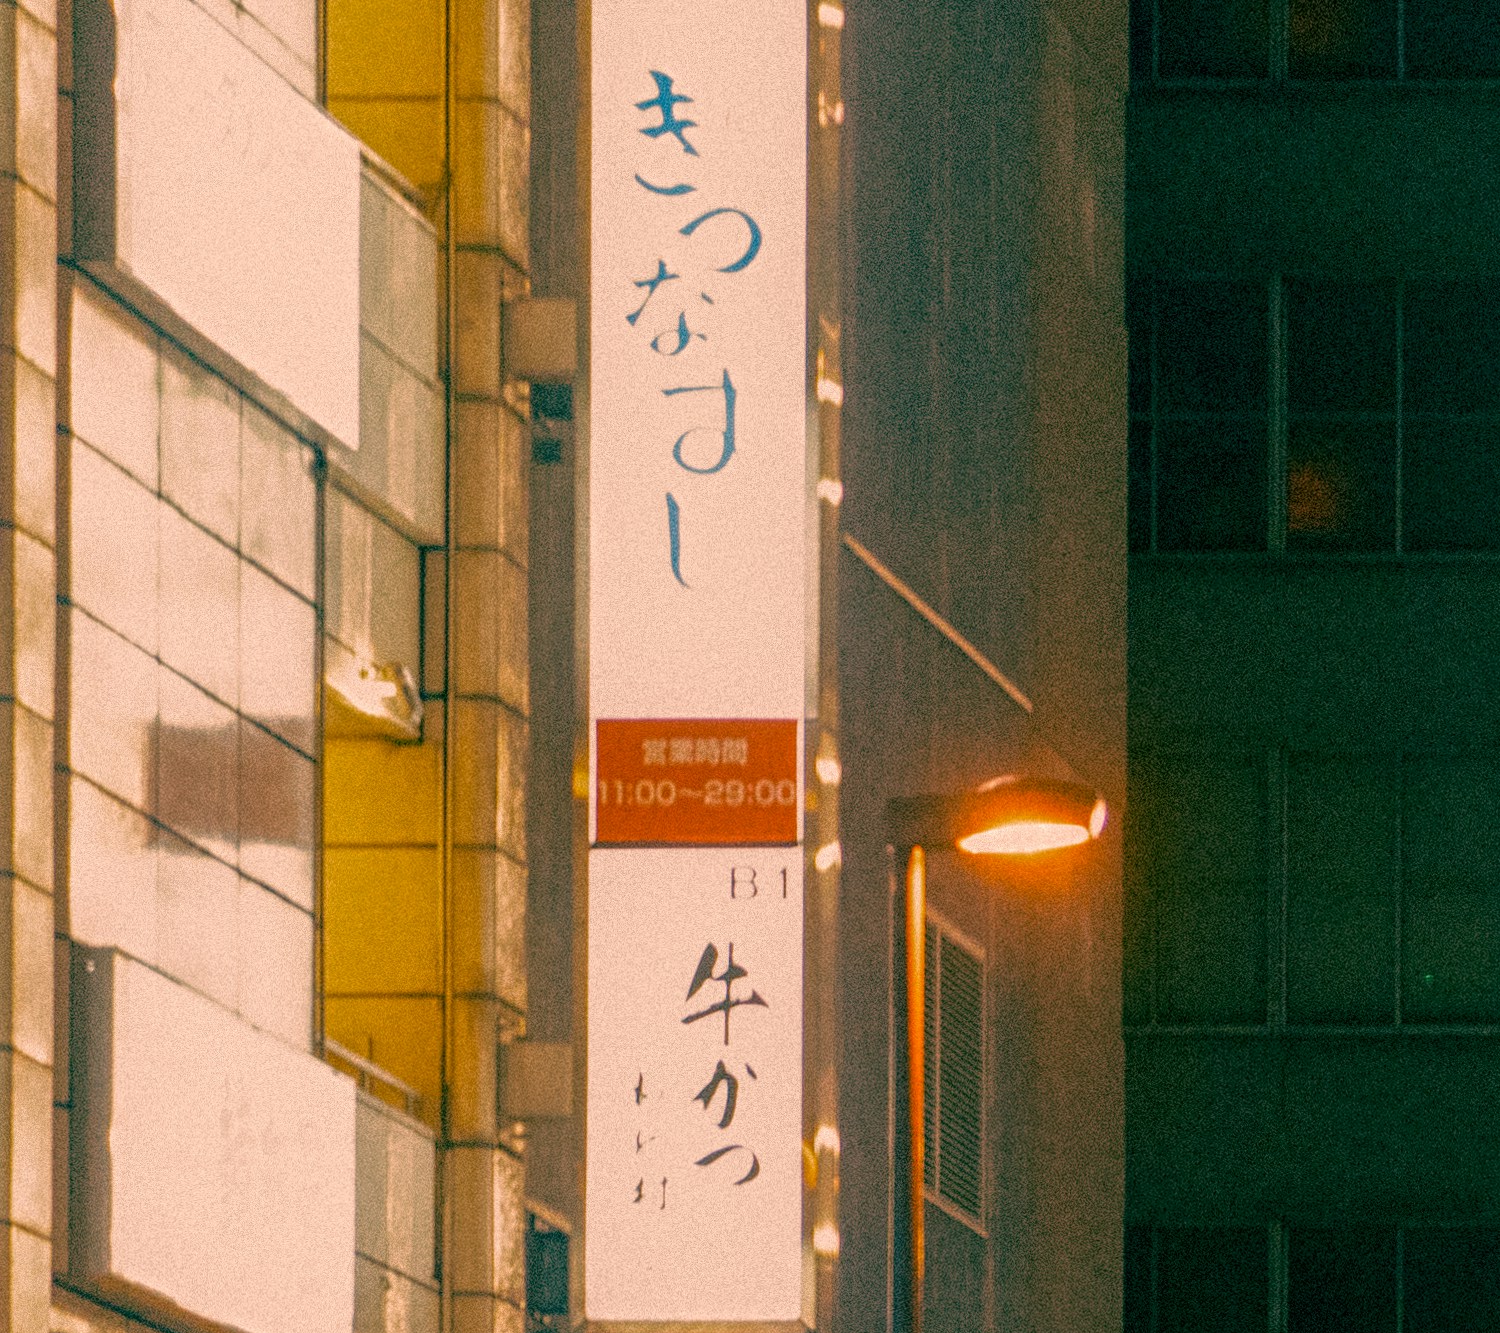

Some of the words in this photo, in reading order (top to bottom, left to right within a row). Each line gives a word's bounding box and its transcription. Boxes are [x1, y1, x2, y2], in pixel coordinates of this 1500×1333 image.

[642, 738, 748, 766] 営業時間
[681, 943, 768, 1185] 牛かつ
